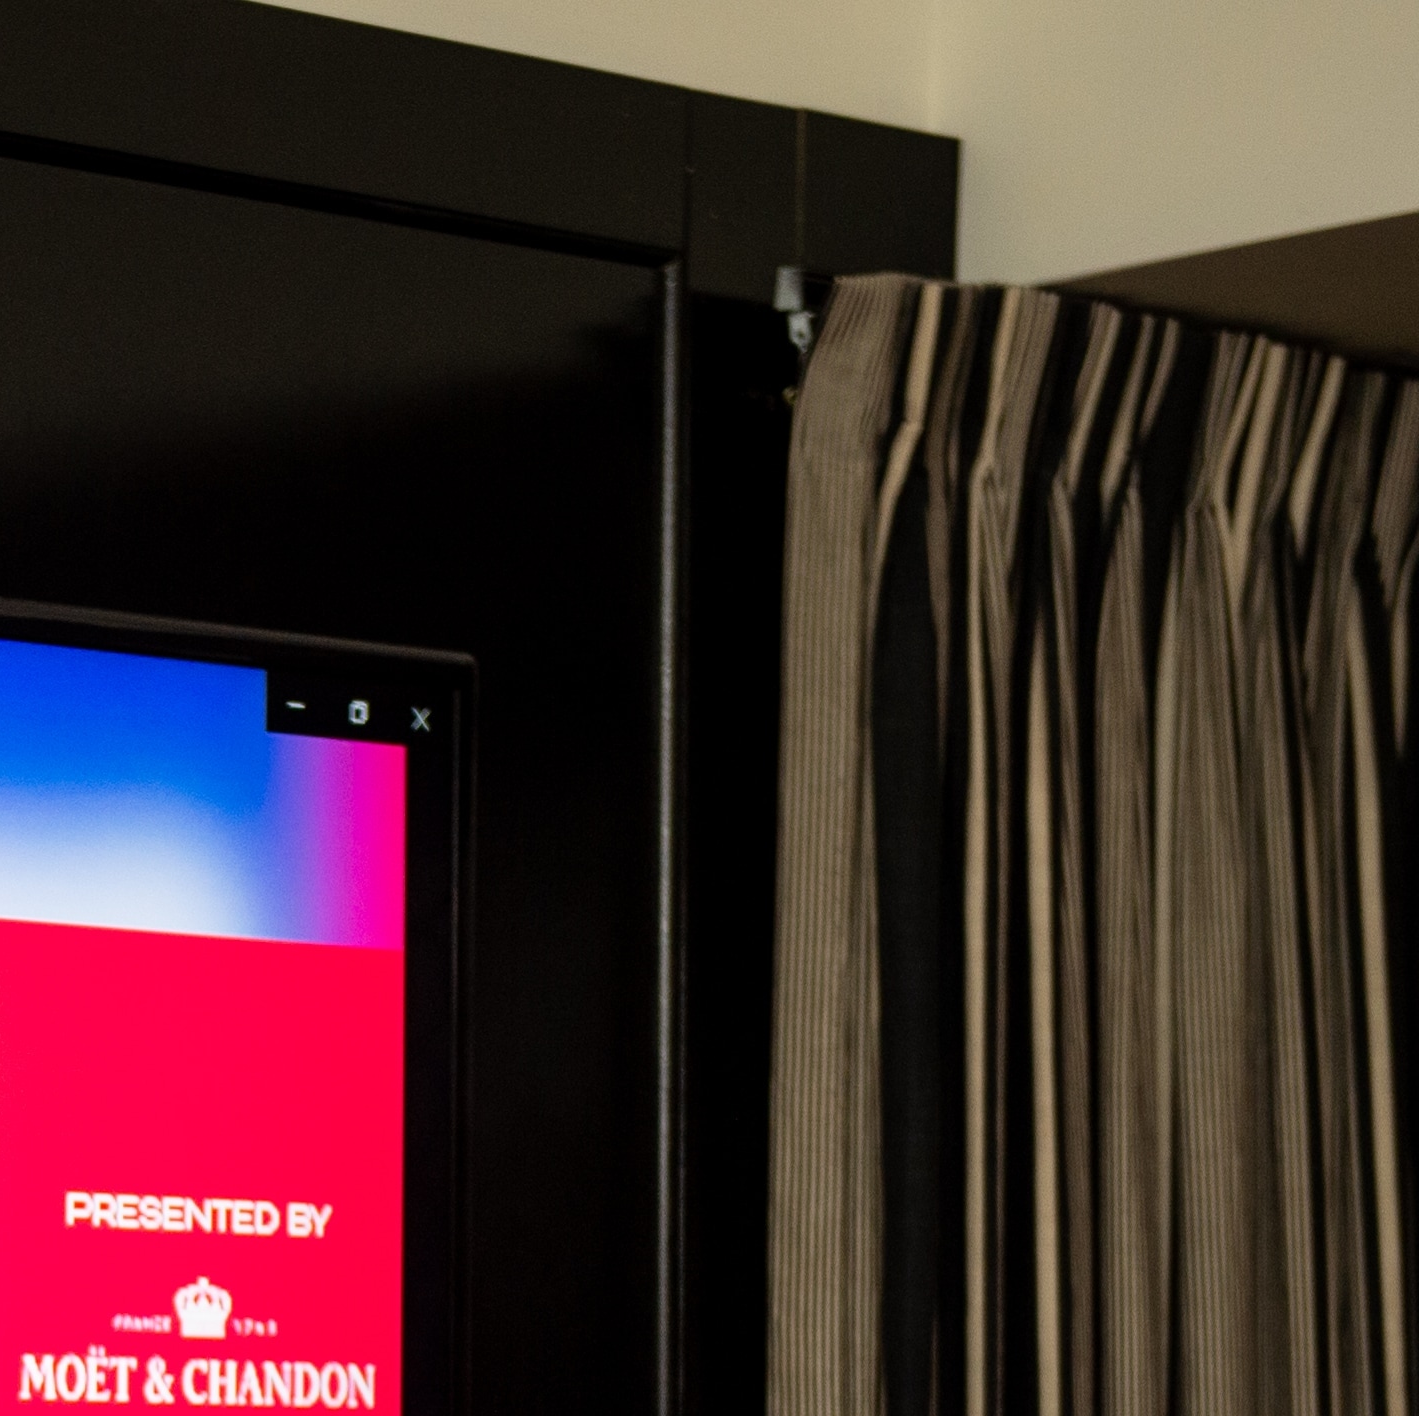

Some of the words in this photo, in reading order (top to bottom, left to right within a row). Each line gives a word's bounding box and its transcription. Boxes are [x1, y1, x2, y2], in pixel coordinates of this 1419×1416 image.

[65, 1191, 280, 1236] PRESENTED
[287, 1202, 332, 1238] BY
[18, 1344, 137, 1403] MOËT
[143, 1355, 175, 1405] &
[181, 1359, 376, 1409] CHANDON
